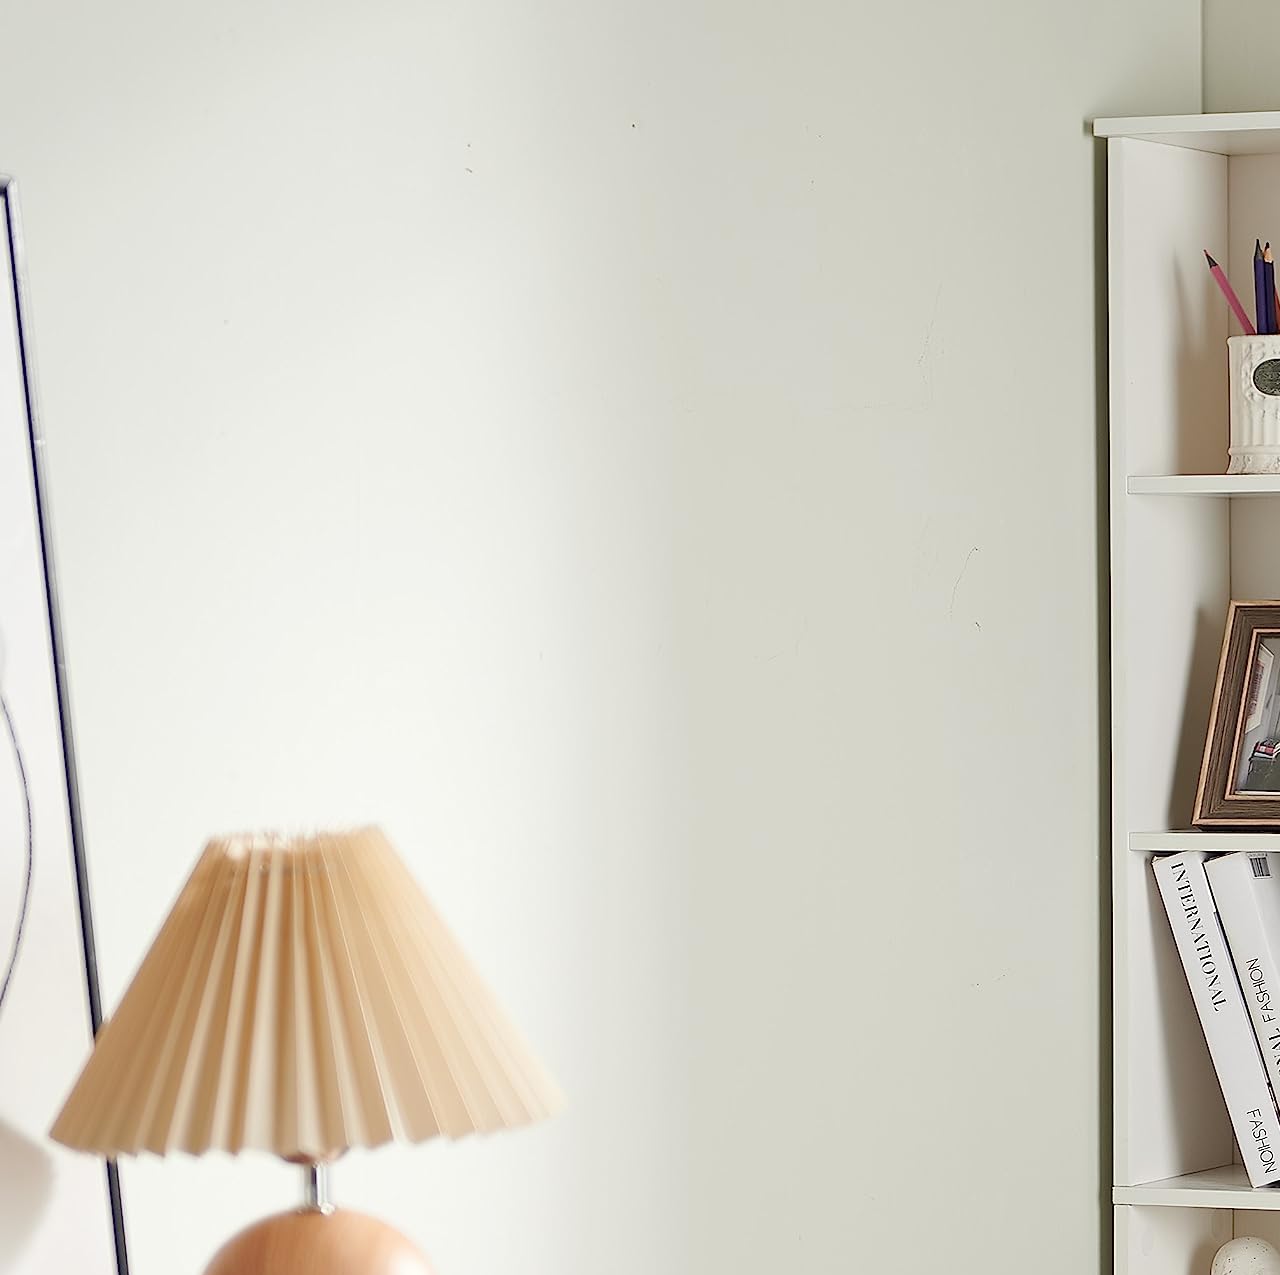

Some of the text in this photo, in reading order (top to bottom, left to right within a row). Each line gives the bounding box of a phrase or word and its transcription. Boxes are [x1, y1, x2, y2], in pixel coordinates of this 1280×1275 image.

[1170, 862, 1278, 1175] INTERNATIONAL FASHION
[1245, 957, 1276, 1023] FASHION
